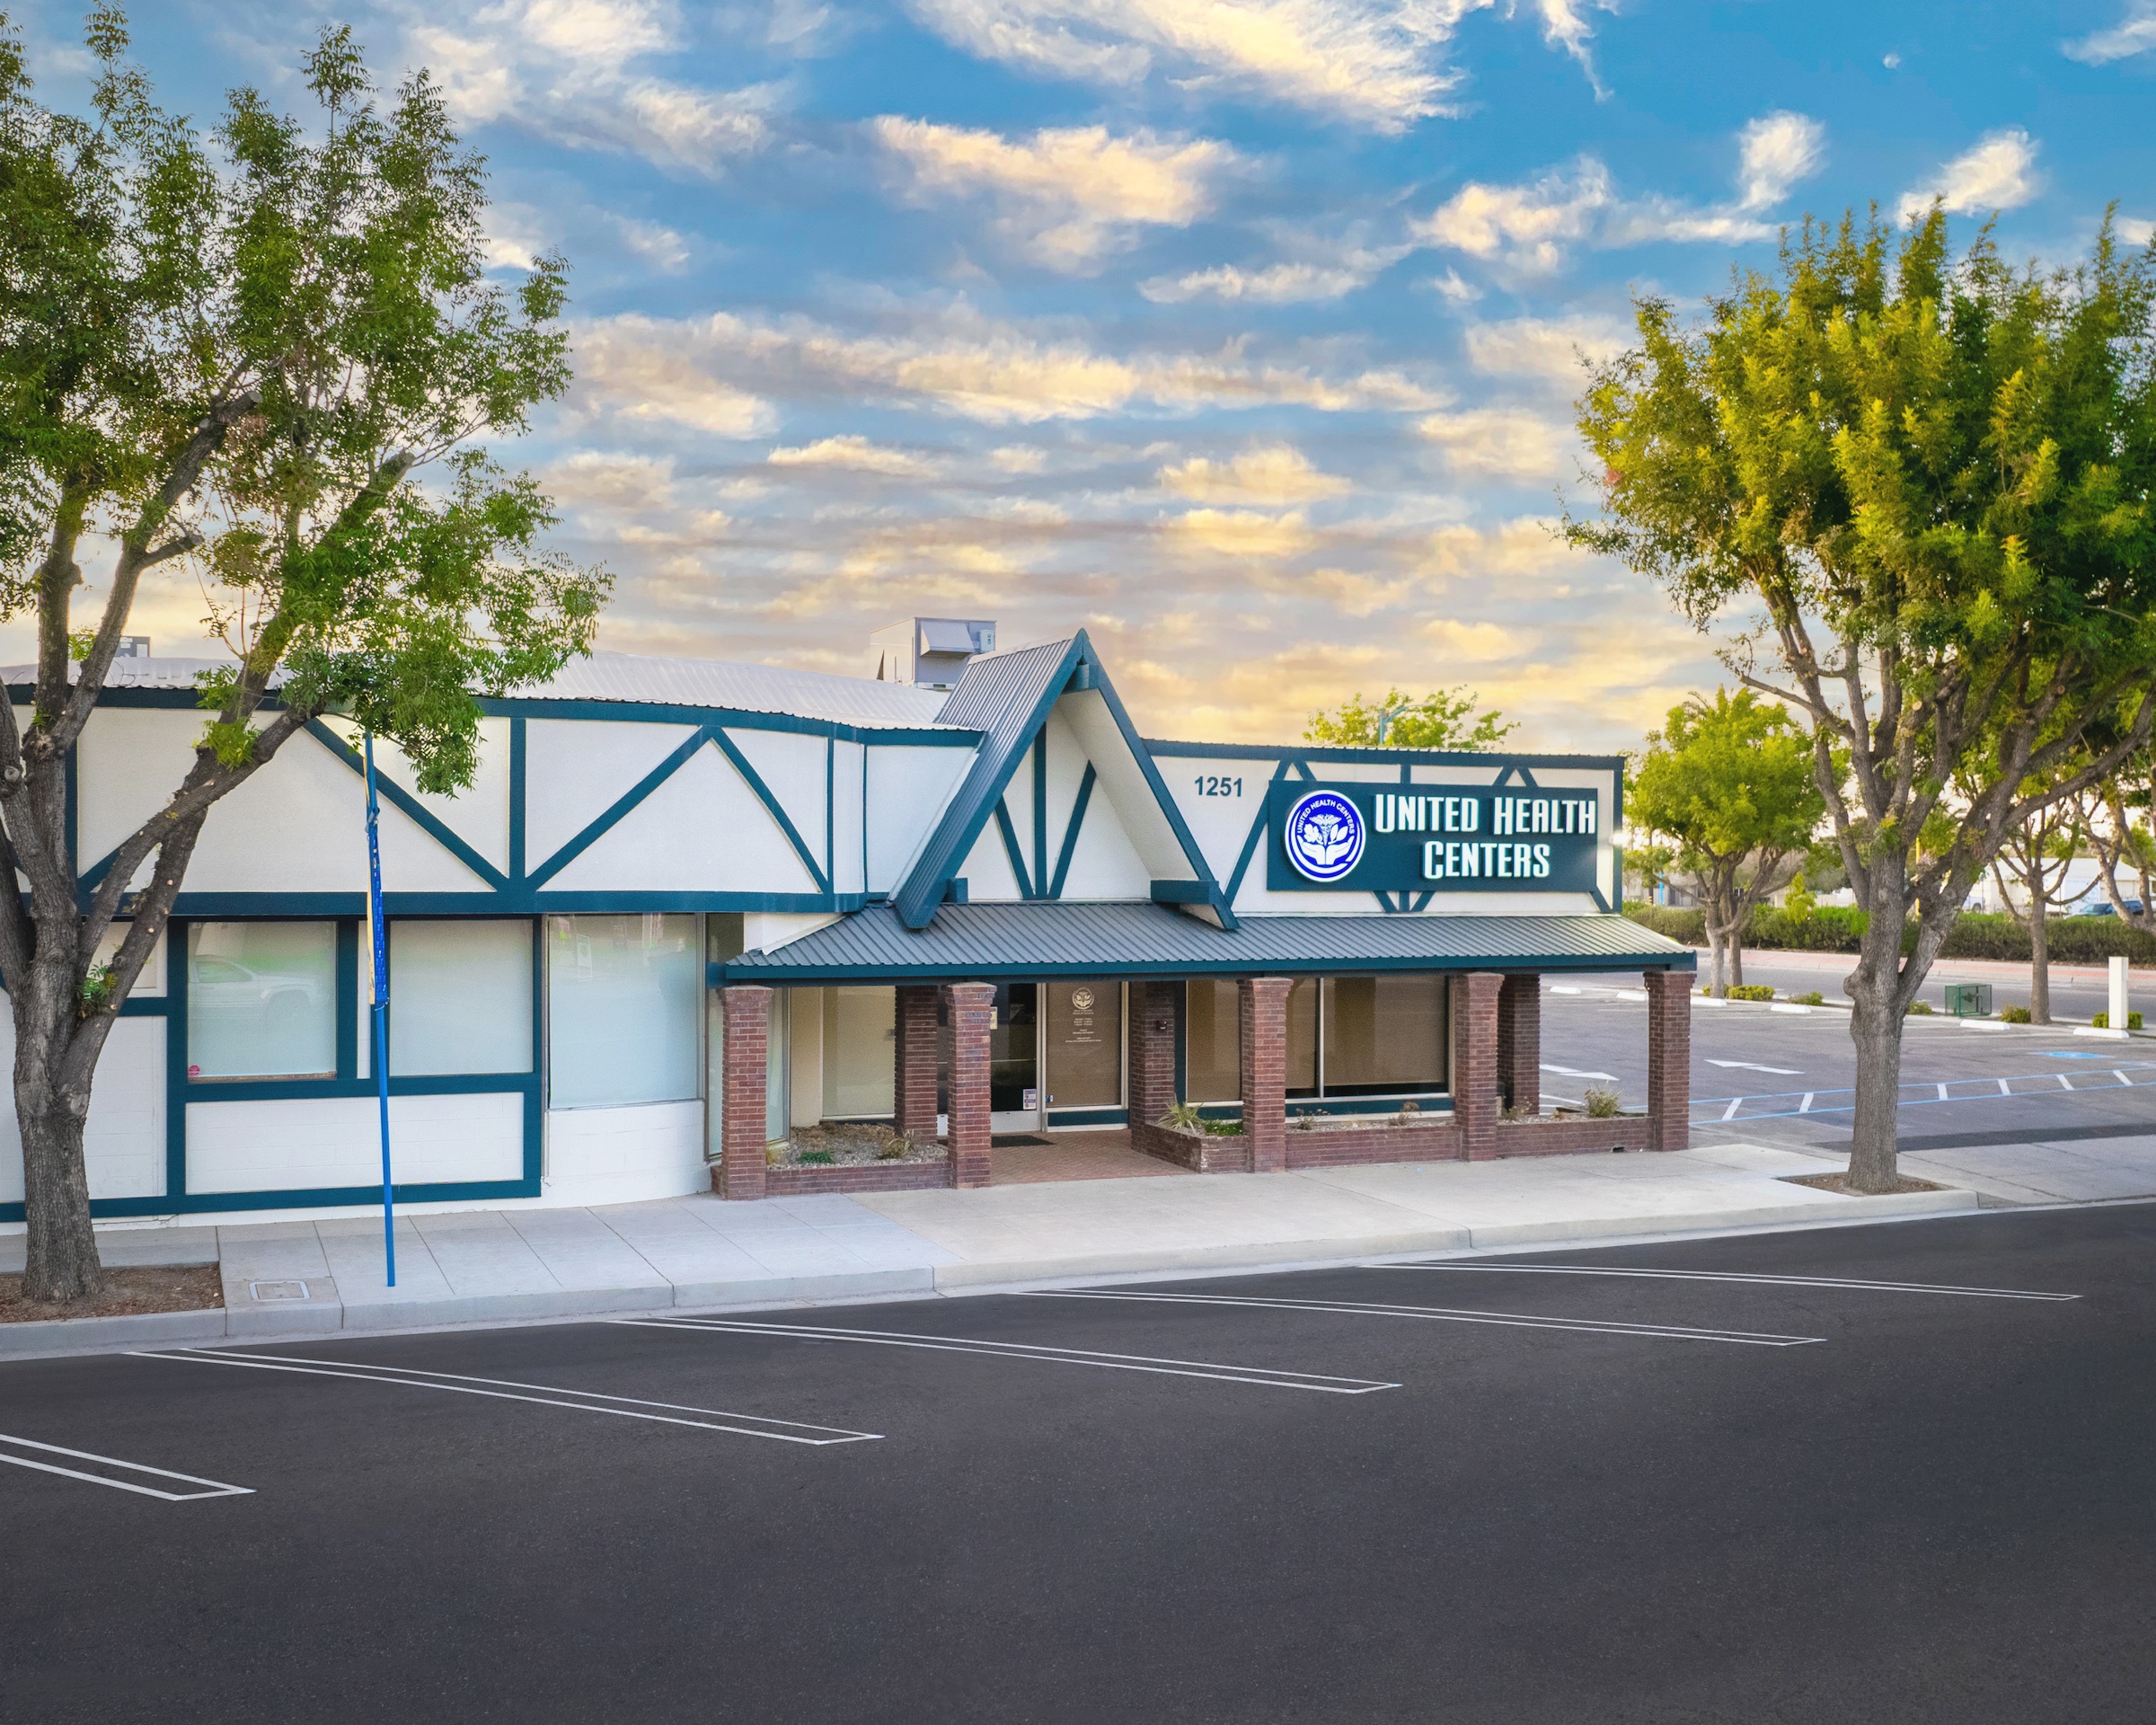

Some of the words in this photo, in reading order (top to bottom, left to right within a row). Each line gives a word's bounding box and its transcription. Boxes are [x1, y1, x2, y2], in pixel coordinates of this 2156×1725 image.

[1195, 776, 1241, 797] 1251
[1297, 808, 1312, 834] UNITED
[1310, 800, 1336, 809] HEALTH
[1336, 803, 1356, 835] CENTERS
[1374, 793, 1480, 833] UNITED
[1493, 797, 1595, 835] HEALTH
[1423, 840, 1551, 880] CENTERS
